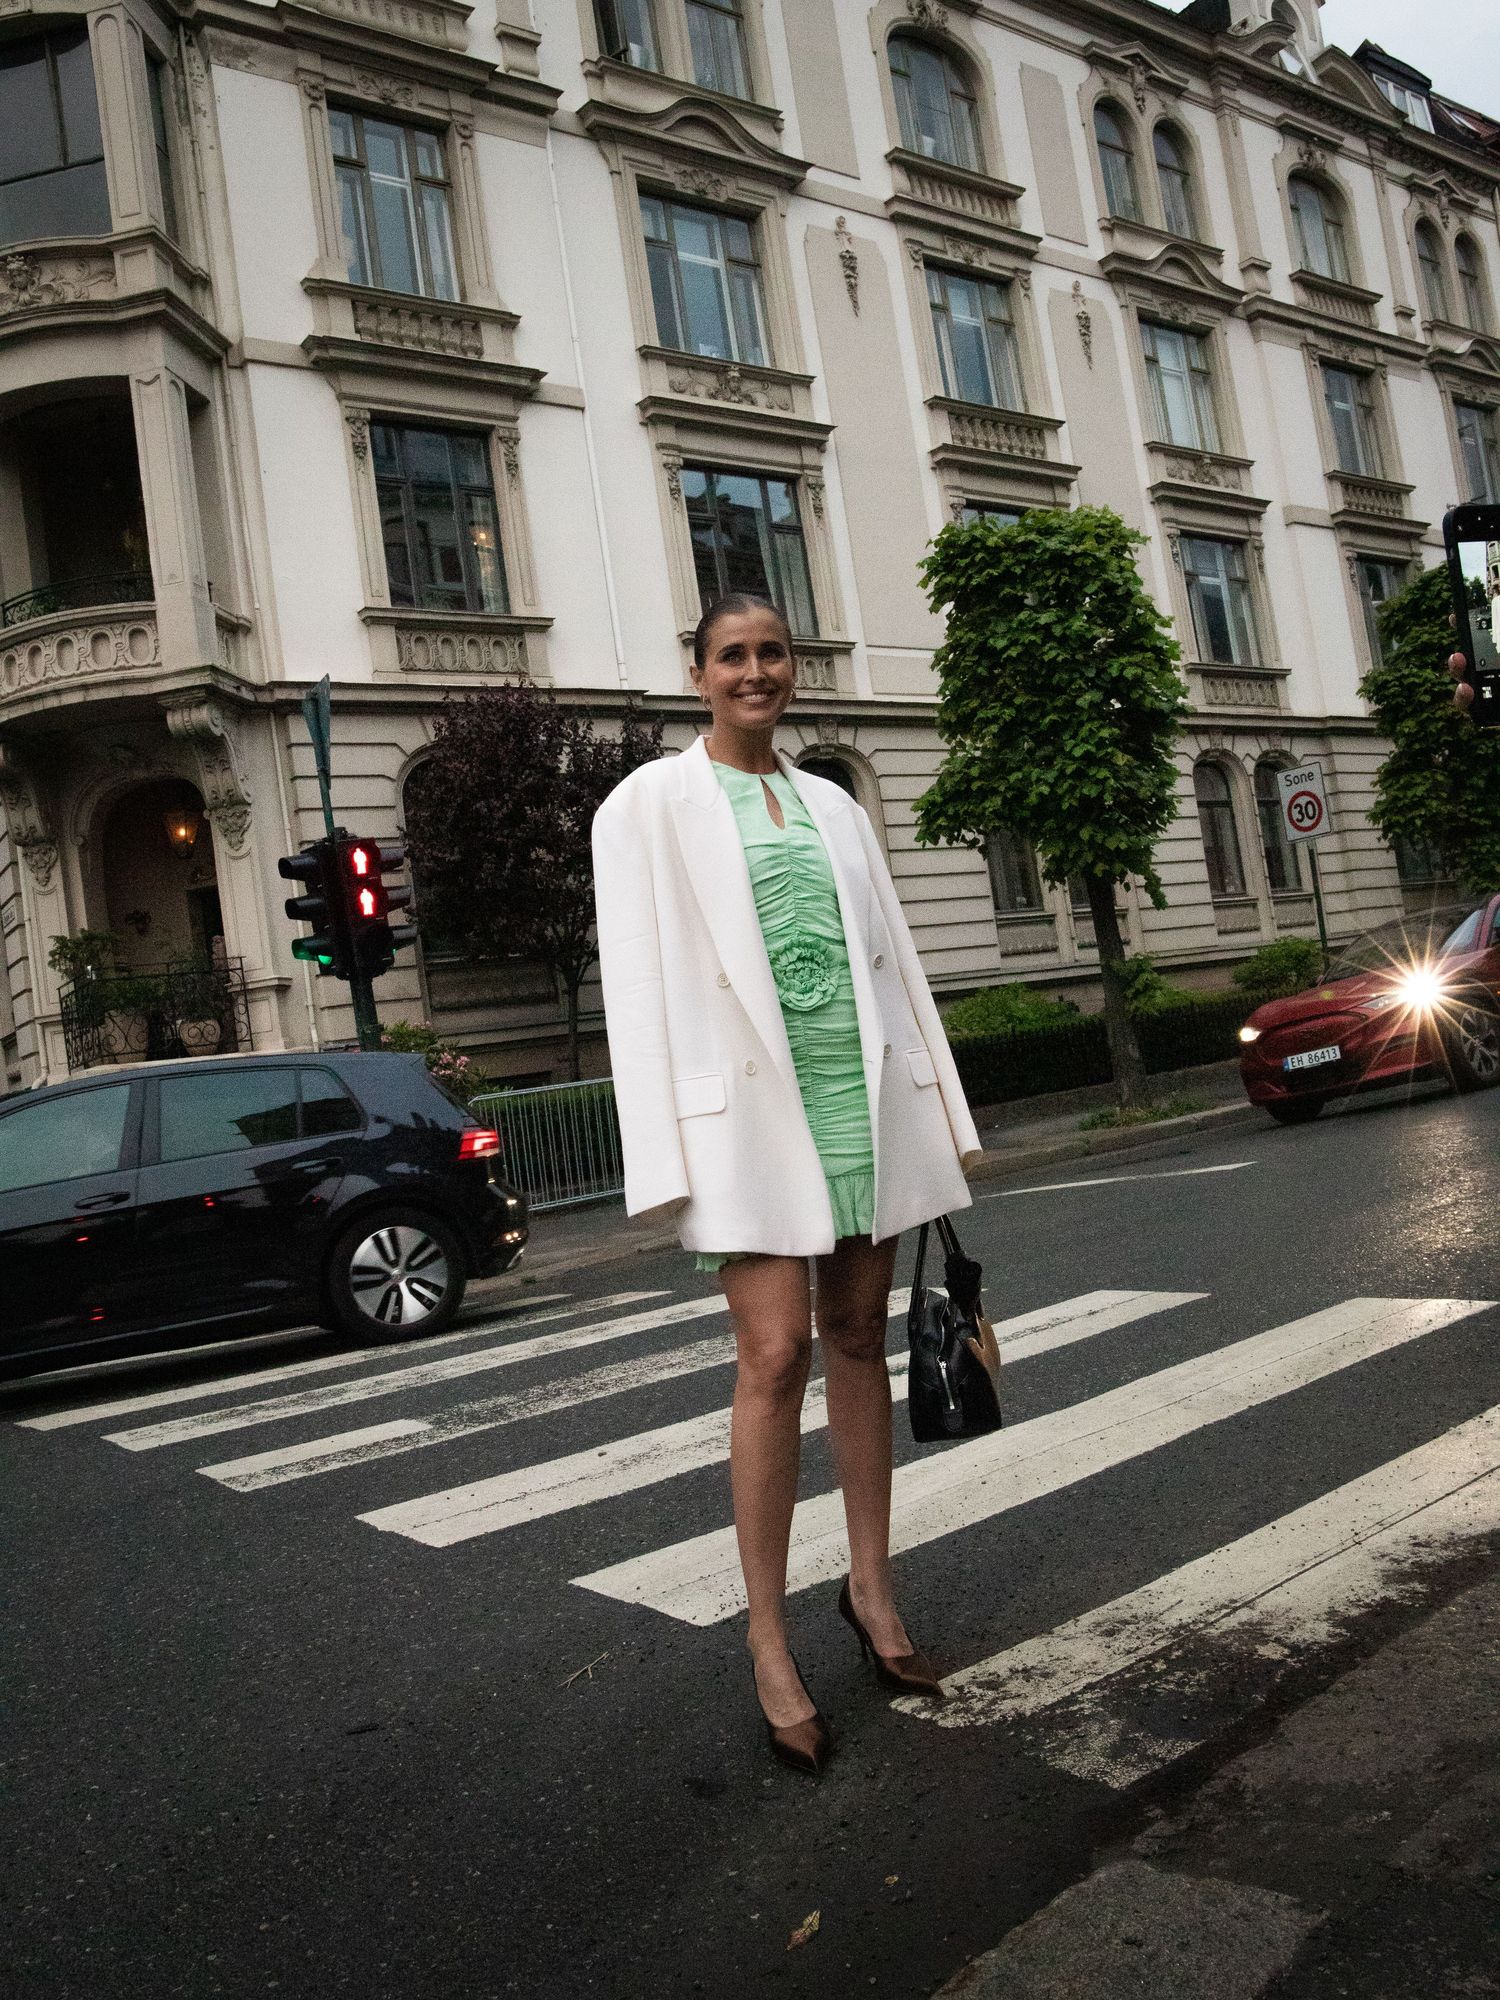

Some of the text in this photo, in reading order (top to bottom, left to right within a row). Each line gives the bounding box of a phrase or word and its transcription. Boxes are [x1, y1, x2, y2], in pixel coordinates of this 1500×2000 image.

[1284, 771, 1314, 787] Sone
[1293, 800, 1317, 823] 30
[1290, 1048, 1338, 1068] EH 86413
